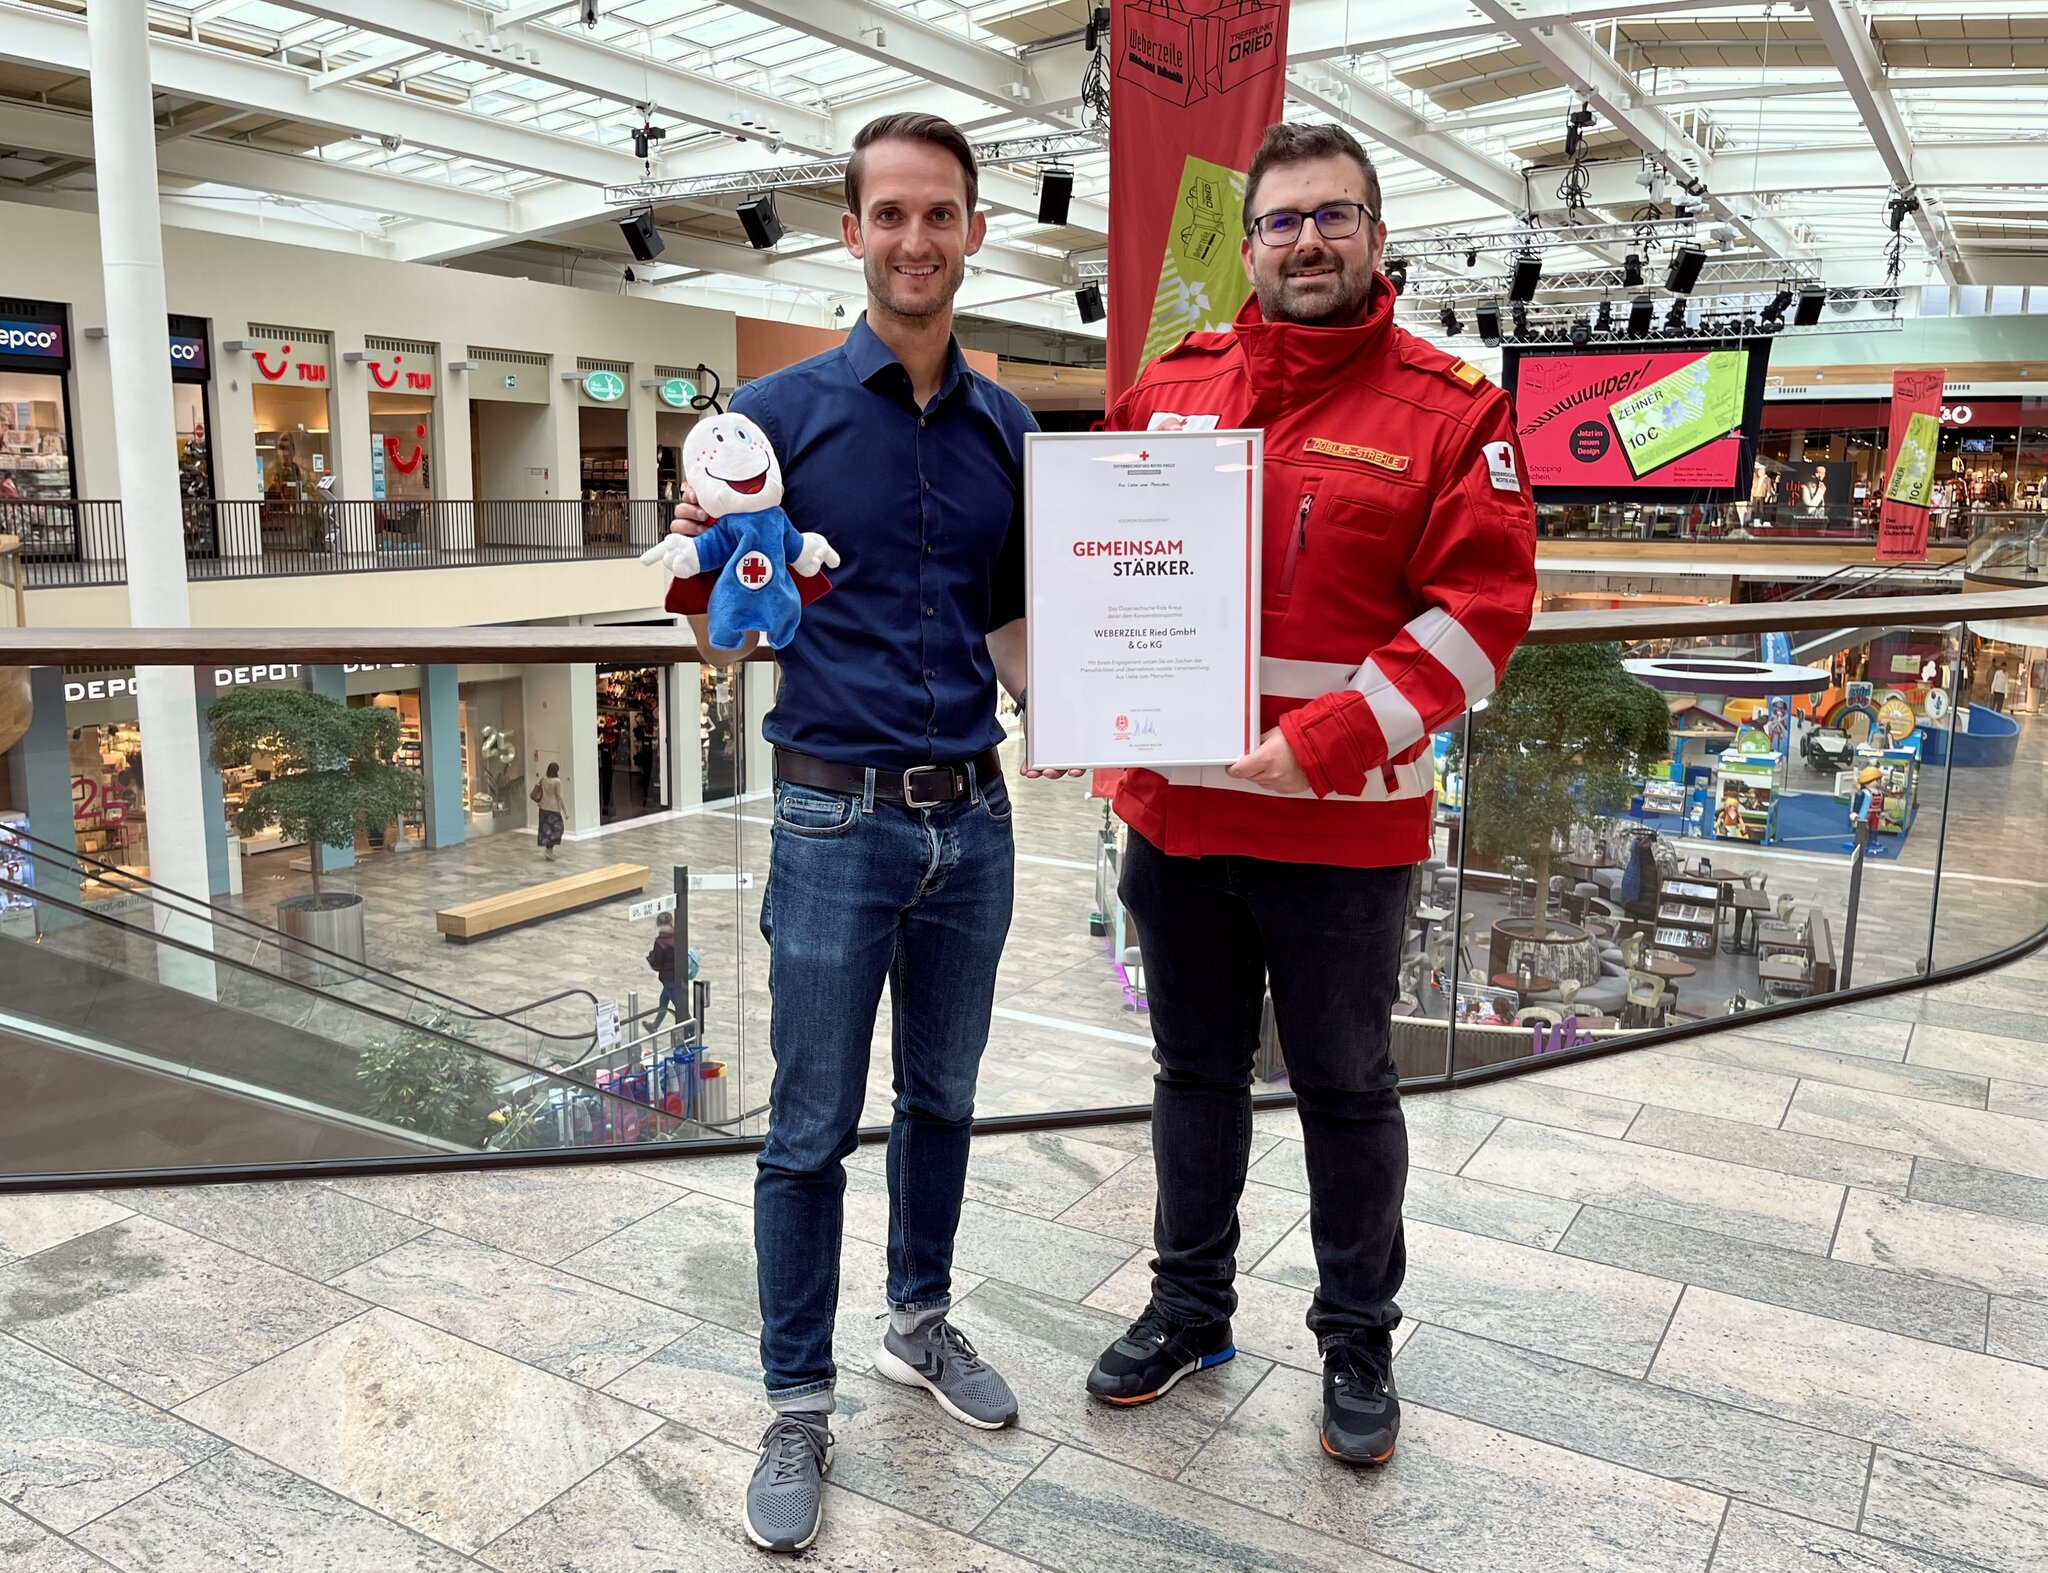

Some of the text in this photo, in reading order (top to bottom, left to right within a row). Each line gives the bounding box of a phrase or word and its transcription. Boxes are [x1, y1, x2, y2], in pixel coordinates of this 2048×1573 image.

[1231, 21, 1274, 44] TREFFPUNKT
[1130, 27, 1183, 68] Weberzeile
[1242, 32, 1274, 58] RIED
[296, 362, 326, 382] TUI
[406, 372, 432, 390] TUI
[1618, 390, 1664, 421] ZEHNER
[1578, 448, 1600, 456] Design
[1530, 465, 1562, 473] Shopping
[1892, 466, 1906, 496] ZEHNER
[1072, 540, 1183, 556] GEMEINSAM
[1112, 558, 1194, 576] STÄRKER.
[1094, 628, 1196, 637] WEBERZEILE Ried GmbH
[214, 664, 302, 686] DEPOT
[481, 726, 516, 765] 25
[71, 778, 128, 826] 25
